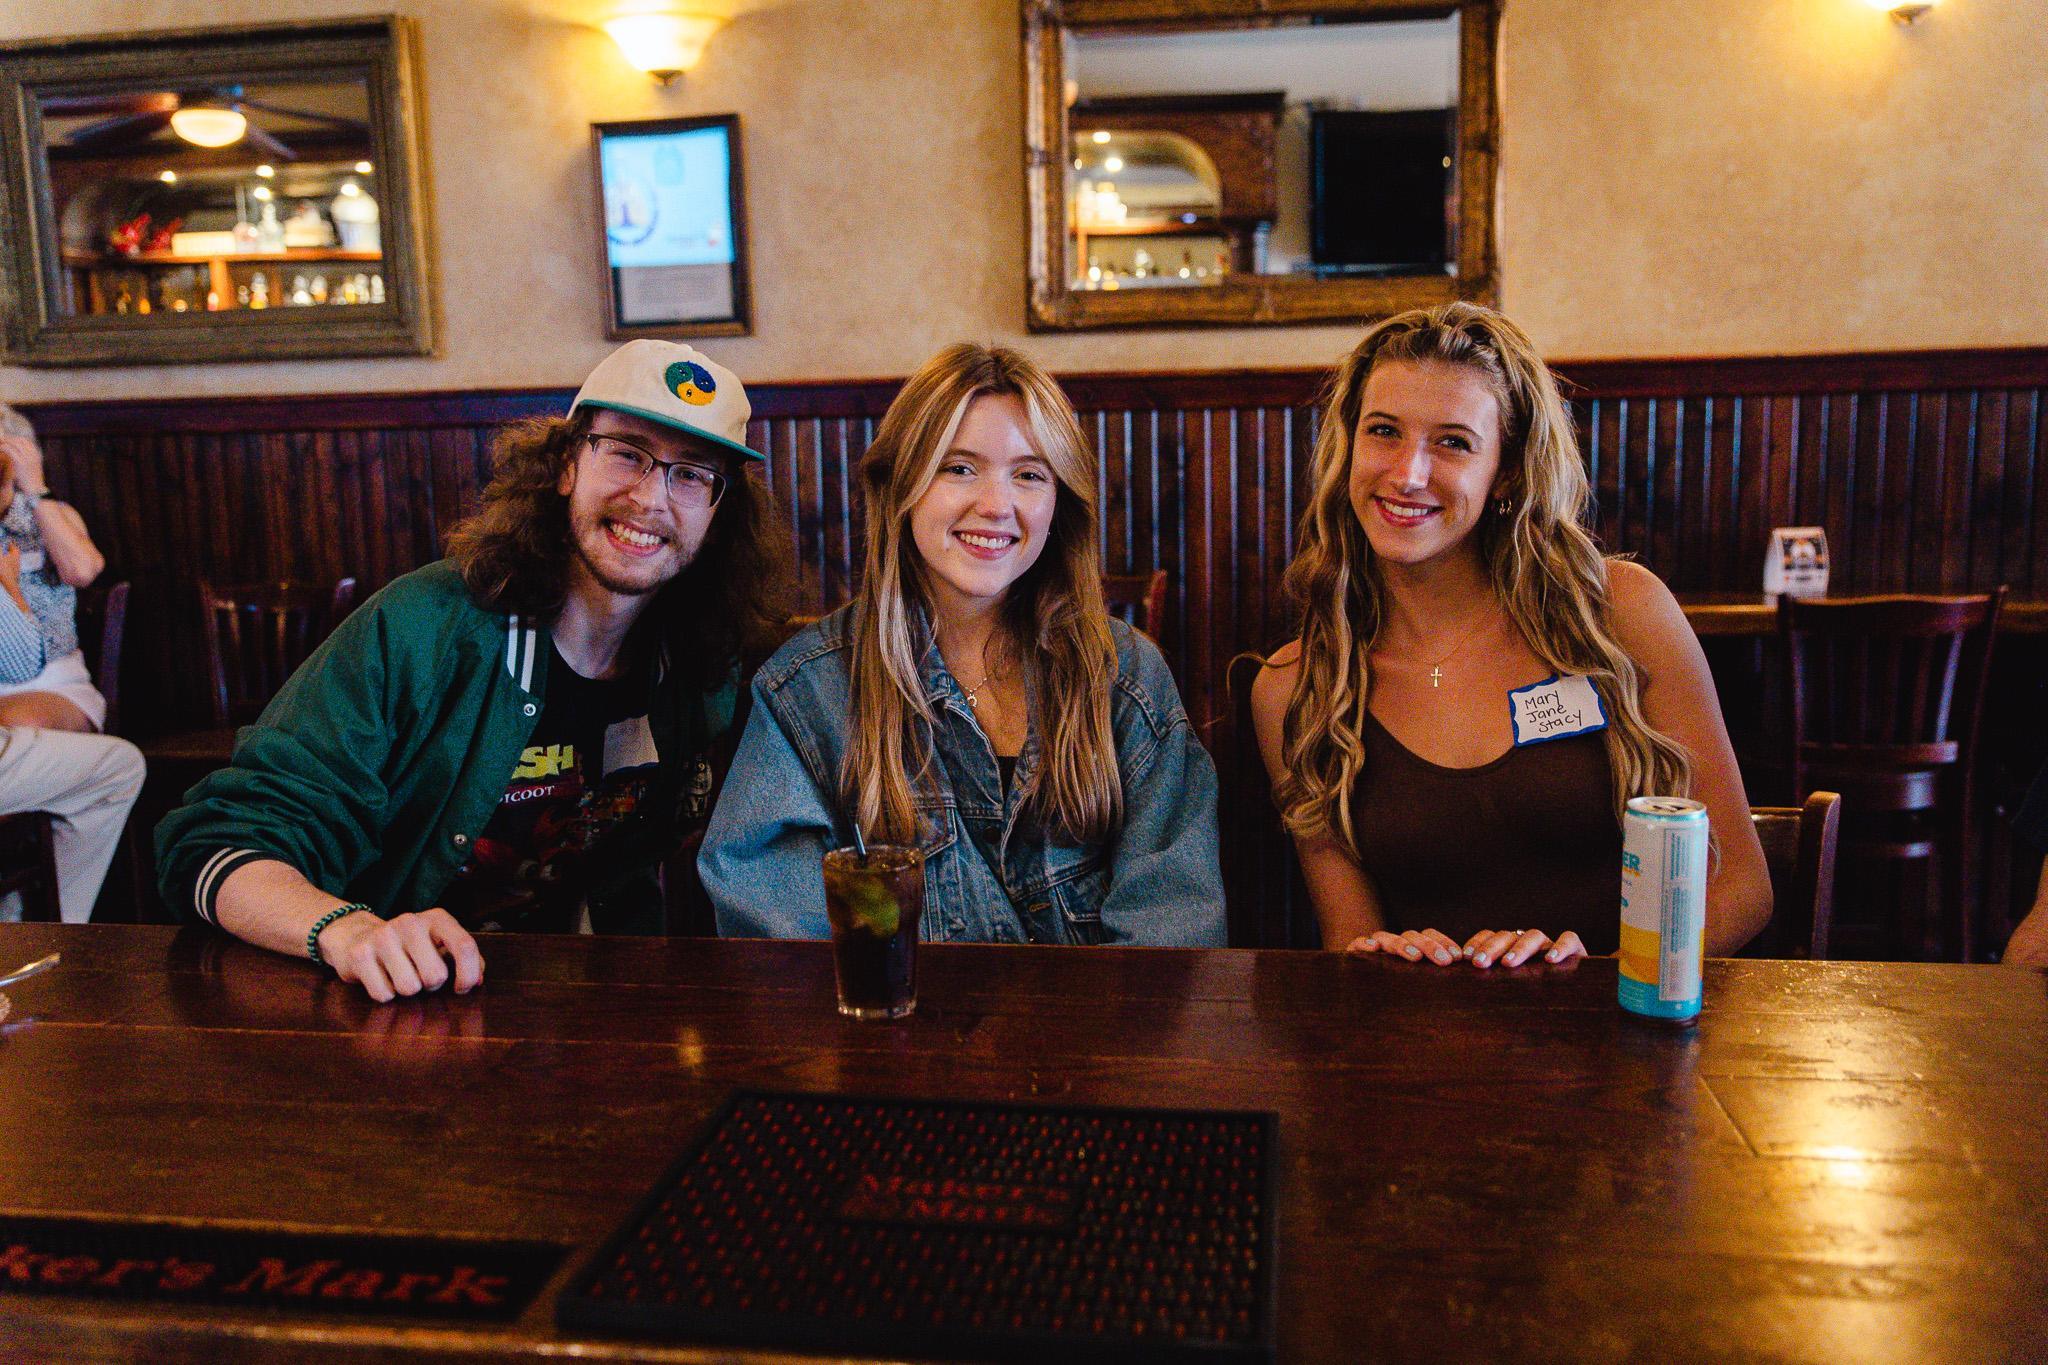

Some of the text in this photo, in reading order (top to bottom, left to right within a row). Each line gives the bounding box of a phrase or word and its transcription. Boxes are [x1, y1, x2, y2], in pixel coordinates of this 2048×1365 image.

[1524, 690, 1560, 709] Mary
[1525, 704, 1567, 723] Jane
[499, 785, 555, 804] ICOOT
[224, 1257, 507, 1303] Mark
